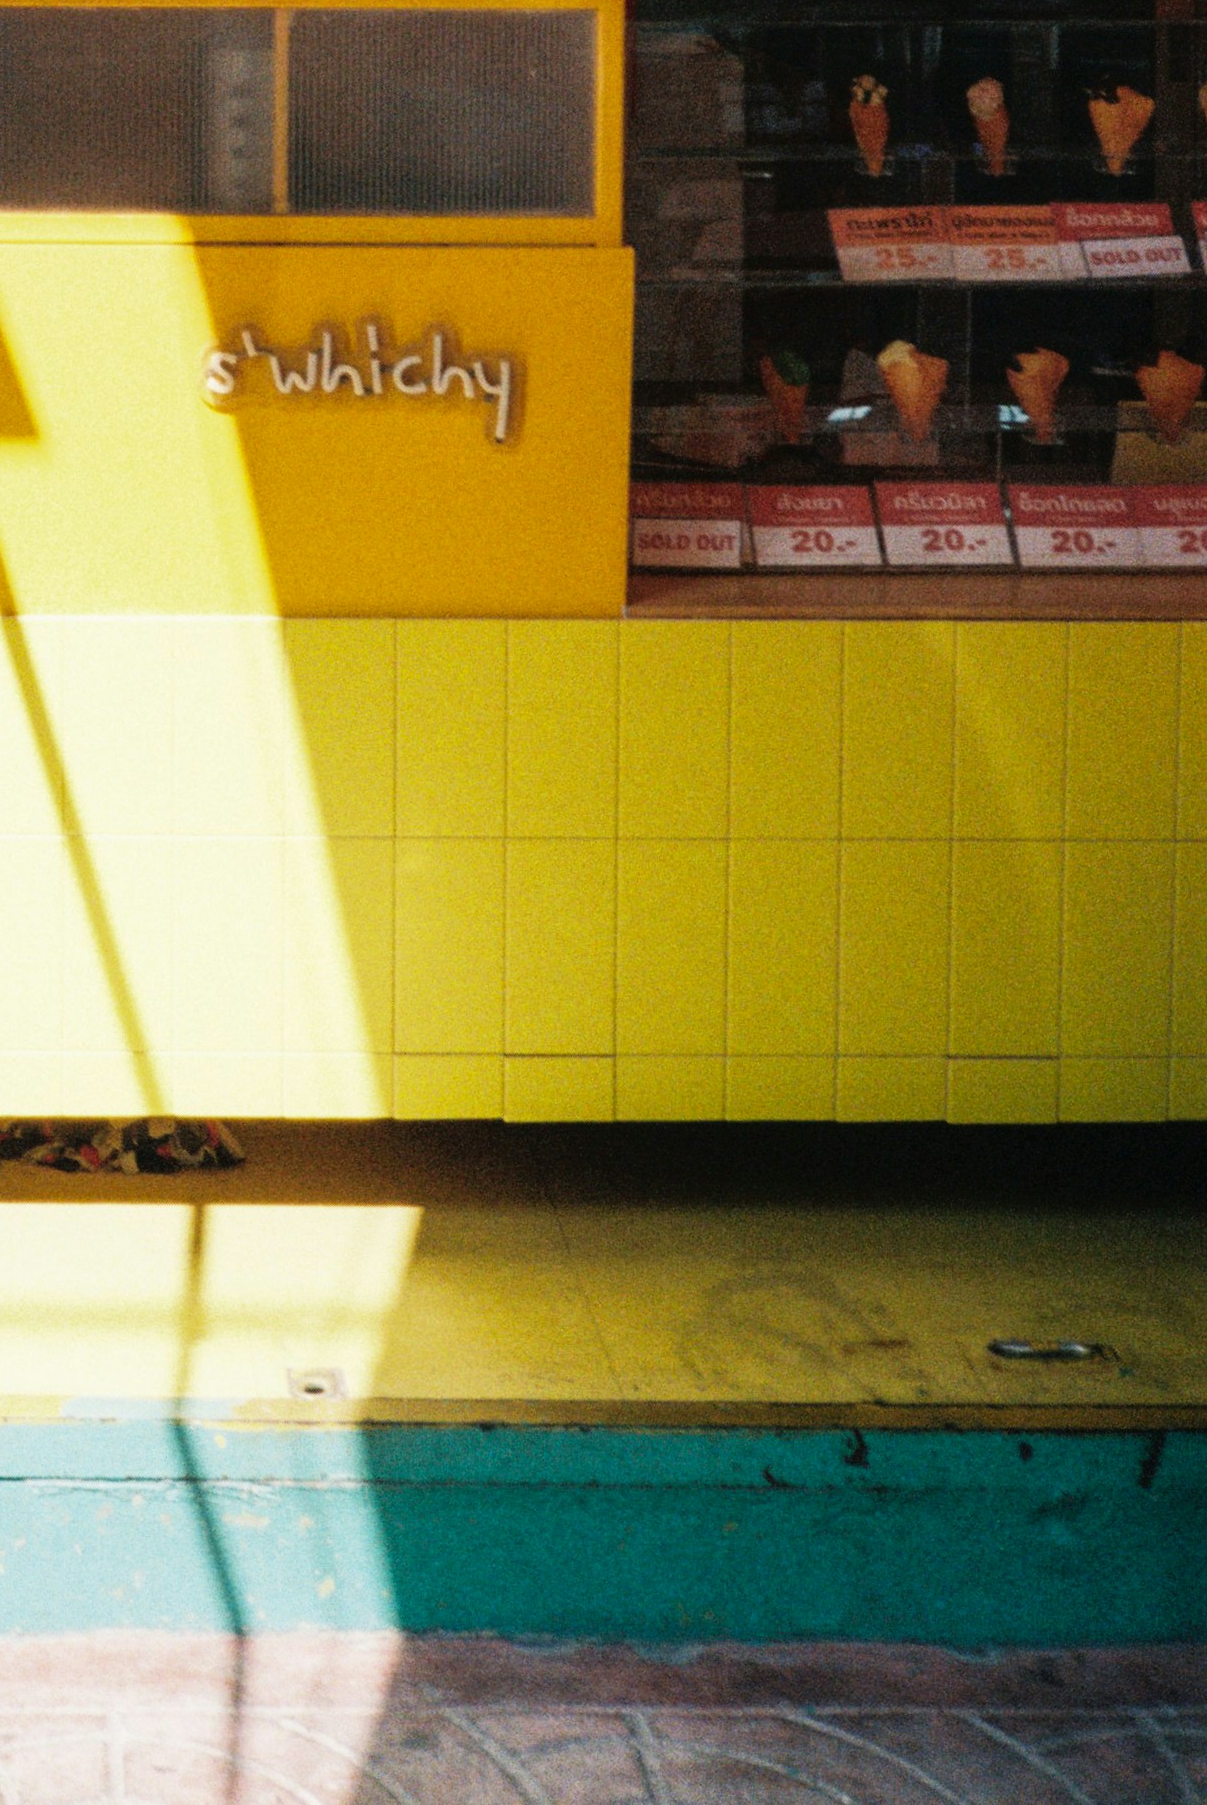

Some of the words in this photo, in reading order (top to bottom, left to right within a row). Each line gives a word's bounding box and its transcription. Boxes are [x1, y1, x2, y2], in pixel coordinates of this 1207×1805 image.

[1090, 249, 1140, 266] SOLD
[1145, 246, 1182, 264] OUT
[636, 532, 690, 551] SOLD
[696, 533, 736, 552] OUT
